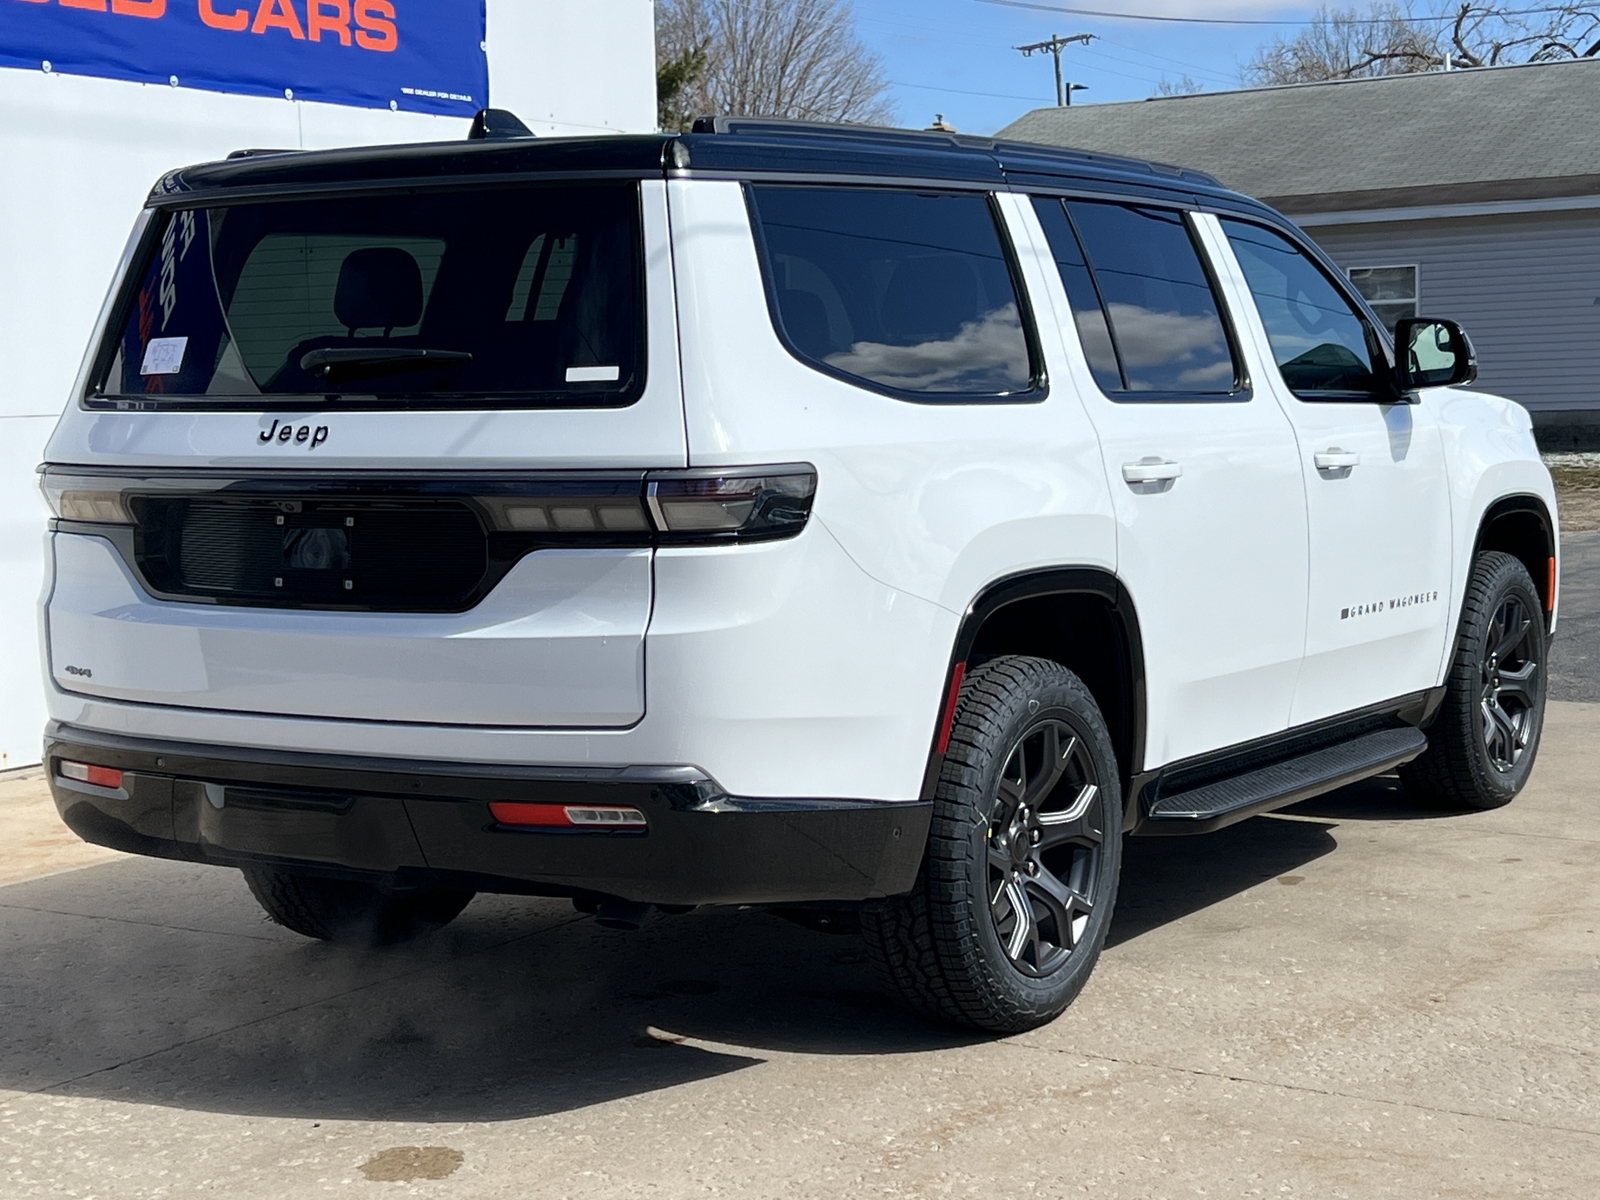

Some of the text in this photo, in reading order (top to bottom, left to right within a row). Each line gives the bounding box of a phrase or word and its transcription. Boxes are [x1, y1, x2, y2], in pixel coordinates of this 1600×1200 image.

[197, 0, 398, 52] CARS
[260, 419, 329, 448] Jeep
[1350, 591, 1438, 617] GRAND WAGONEER
